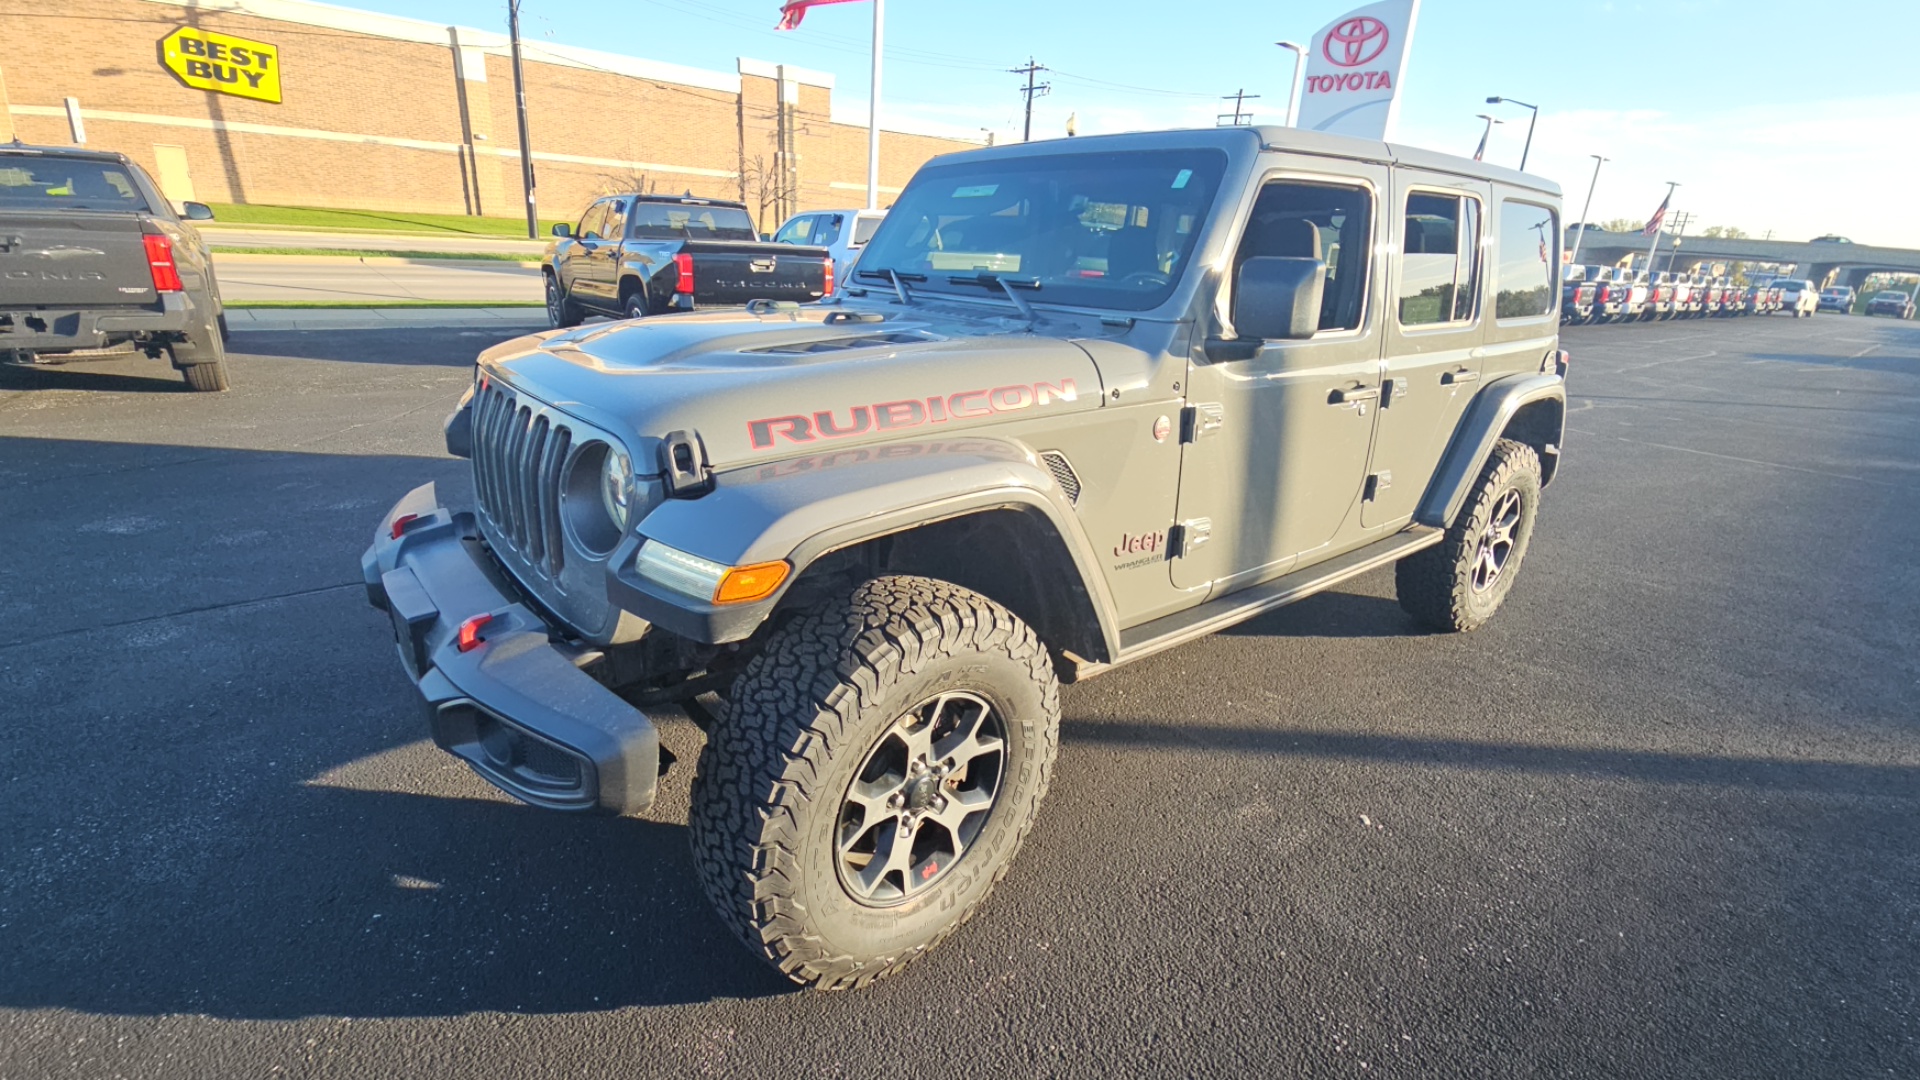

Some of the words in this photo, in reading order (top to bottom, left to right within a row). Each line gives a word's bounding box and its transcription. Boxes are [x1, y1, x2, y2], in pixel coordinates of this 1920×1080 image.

[179, 36, 272, 69] BEST
[186, 58, 265, 88] BUY
[1307, 70, 1391, 93] TOYOTA
[4, 270, 107, 280] OMA
[716, 279, 806, 288] TACOMA
[747, 378, 1077, 449] RUBICON
[1113, 530, 1163, 557] Jeep
[1114, 554, 1163, 570] WRANGLER
